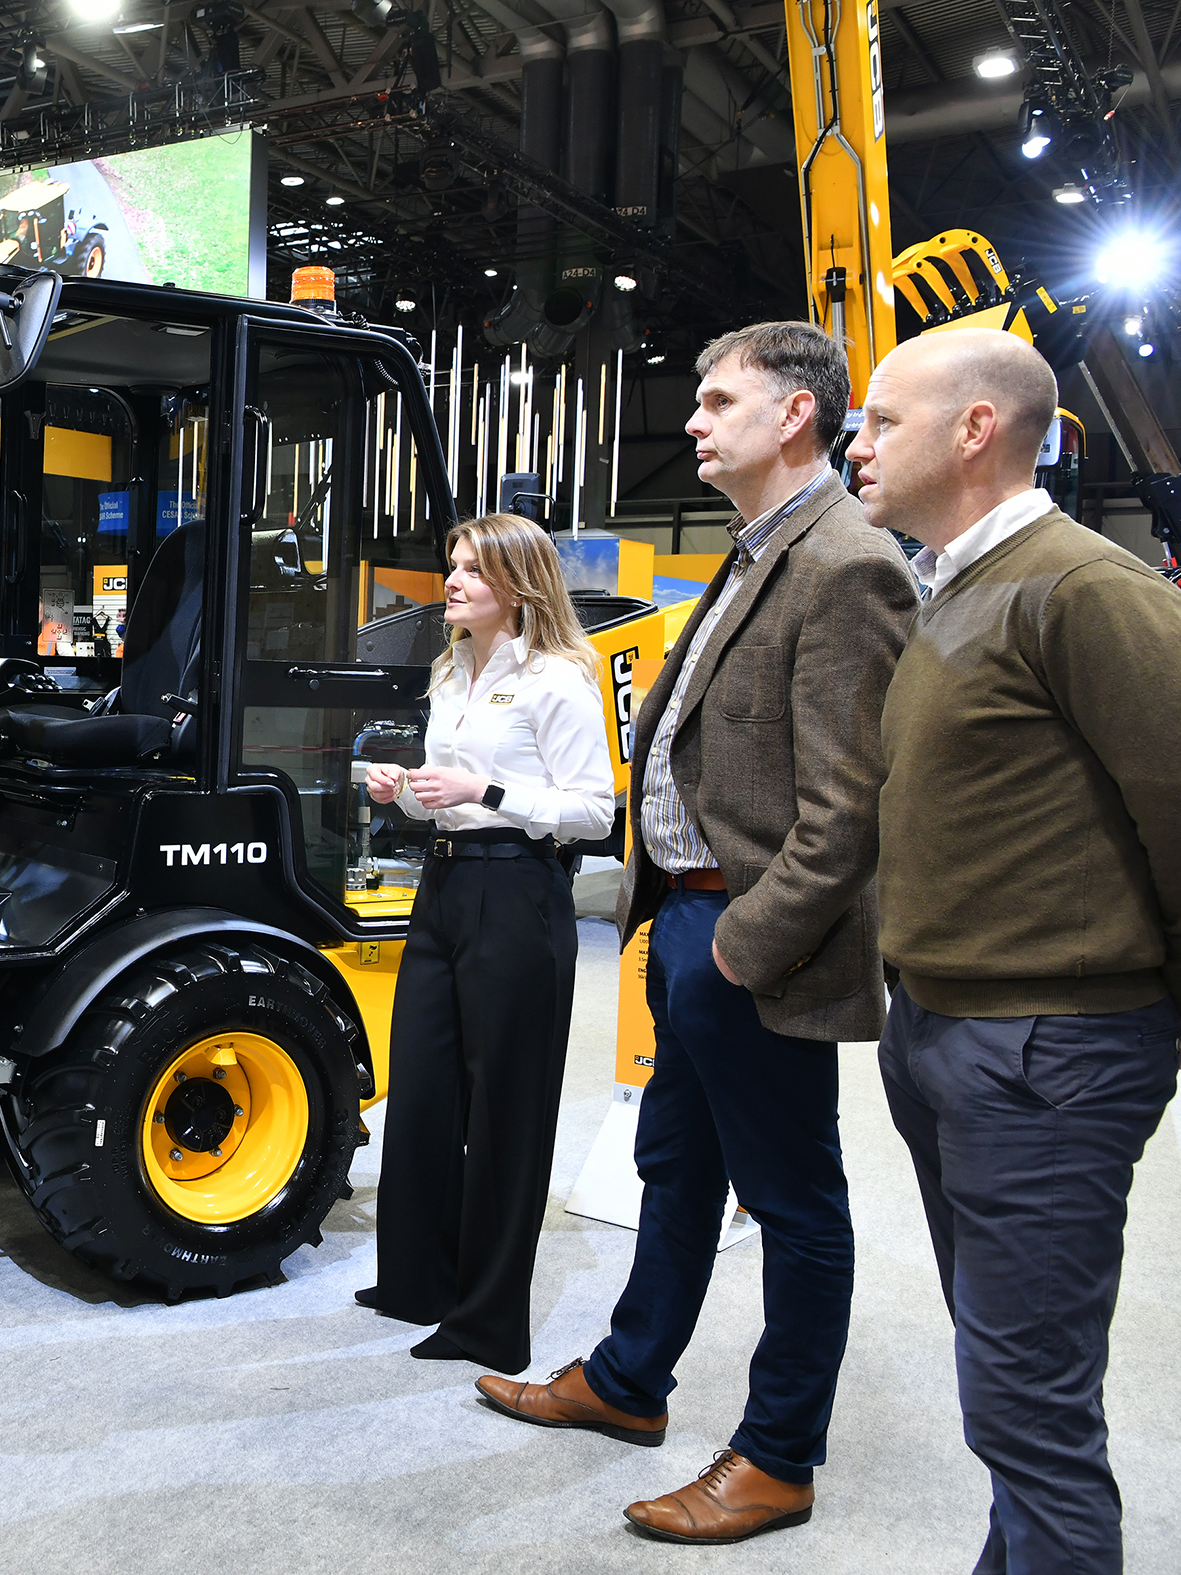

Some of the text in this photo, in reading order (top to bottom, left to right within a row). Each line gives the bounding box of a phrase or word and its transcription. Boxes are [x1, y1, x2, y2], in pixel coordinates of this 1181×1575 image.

[867, 2, 884, 138] JCB
[985, 249, 1002, 274] JCB
[103, 577, 127, 590] JC
[492, 695, 513, 703] JCB
[159, 842, 268, 866] TM110
[248, 995, 327, 1049] EARTHMOVER
[634, 1055, 655, 1067] JC
[141, 1223, 227, 1266] EARTHMOVER
